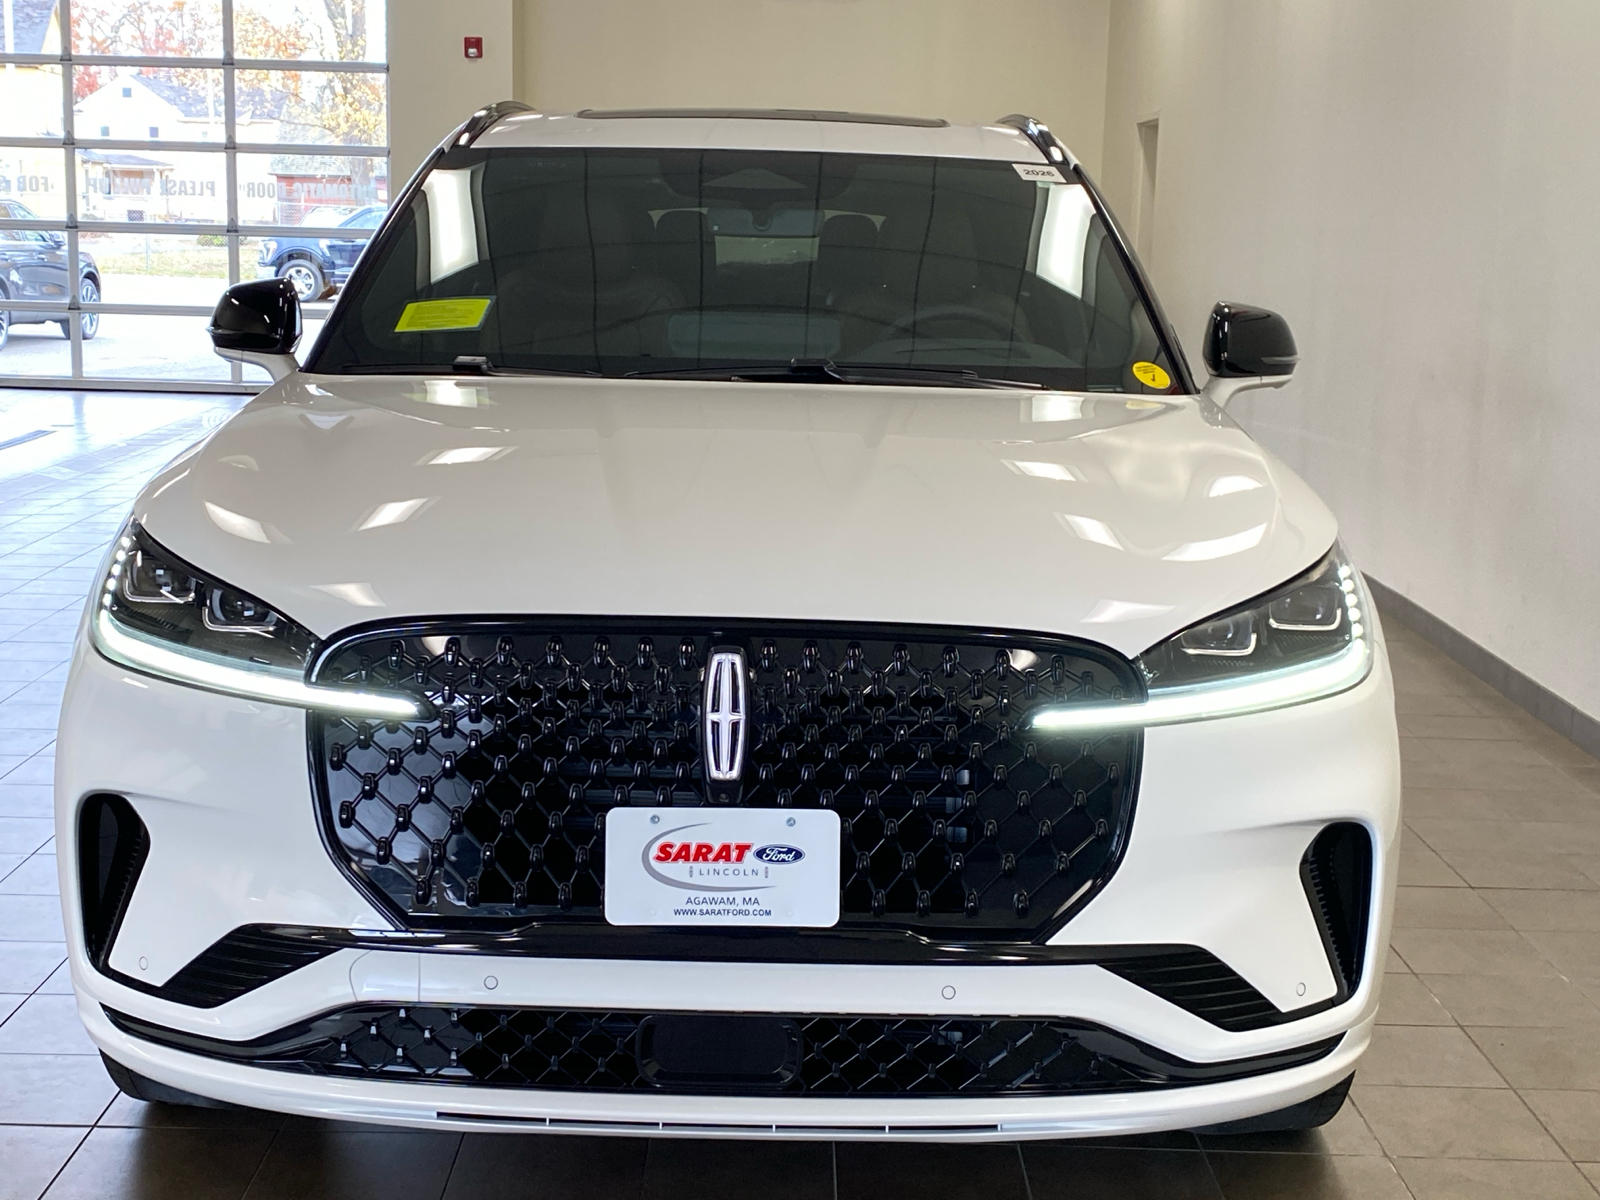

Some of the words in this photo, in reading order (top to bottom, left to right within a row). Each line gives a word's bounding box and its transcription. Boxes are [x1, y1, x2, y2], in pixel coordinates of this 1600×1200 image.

[1023, 169, 1055, 177] 2026
[653, 841, 754, 864] SARAT
[762, 847, 797, 863] Ford
[699, 868, 759, 877] LINCOLN
[686, 896, 740, 907] AGAWAM,
[742, 896, 761, 906] MA
[674, 908, 772, 917] WWW.SARATFORD.COM
